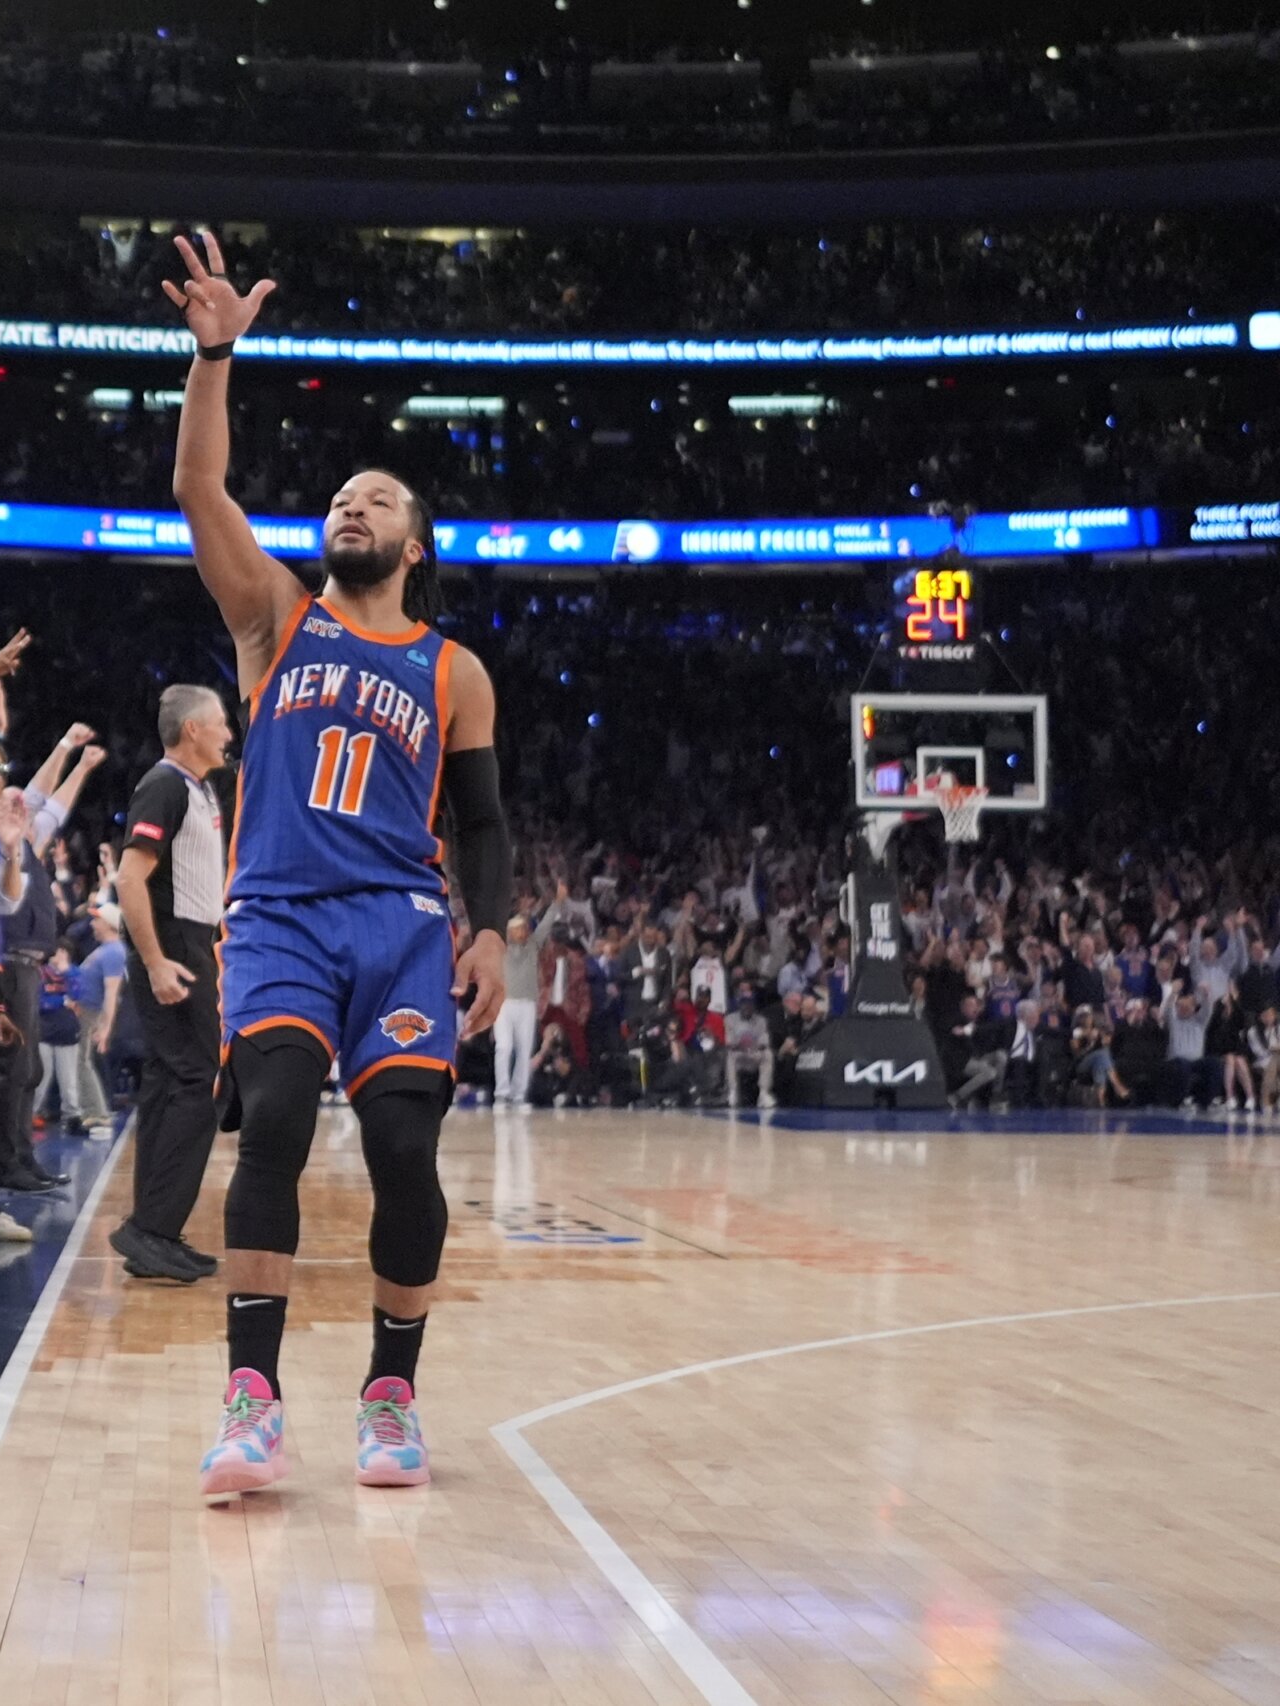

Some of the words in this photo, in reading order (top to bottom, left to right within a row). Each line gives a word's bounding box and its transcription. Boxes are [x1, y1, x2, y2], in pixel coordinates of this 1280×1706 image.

[476, 534, 528, 559] 6:37
[548, 527, 584, 552] 64
[680, 529, 756, 554] INDIANA
[759, 528, 830, 552] PACERS
[915, 570, 970, 600] 6:37
[906, 595, 964, 641] 24
[919, 645, 974, 659] TISSOT
[274, 663, 350, 715] NEW
[355, 670, 430, 760] YORK
[308, 725, 376, 816] 11
